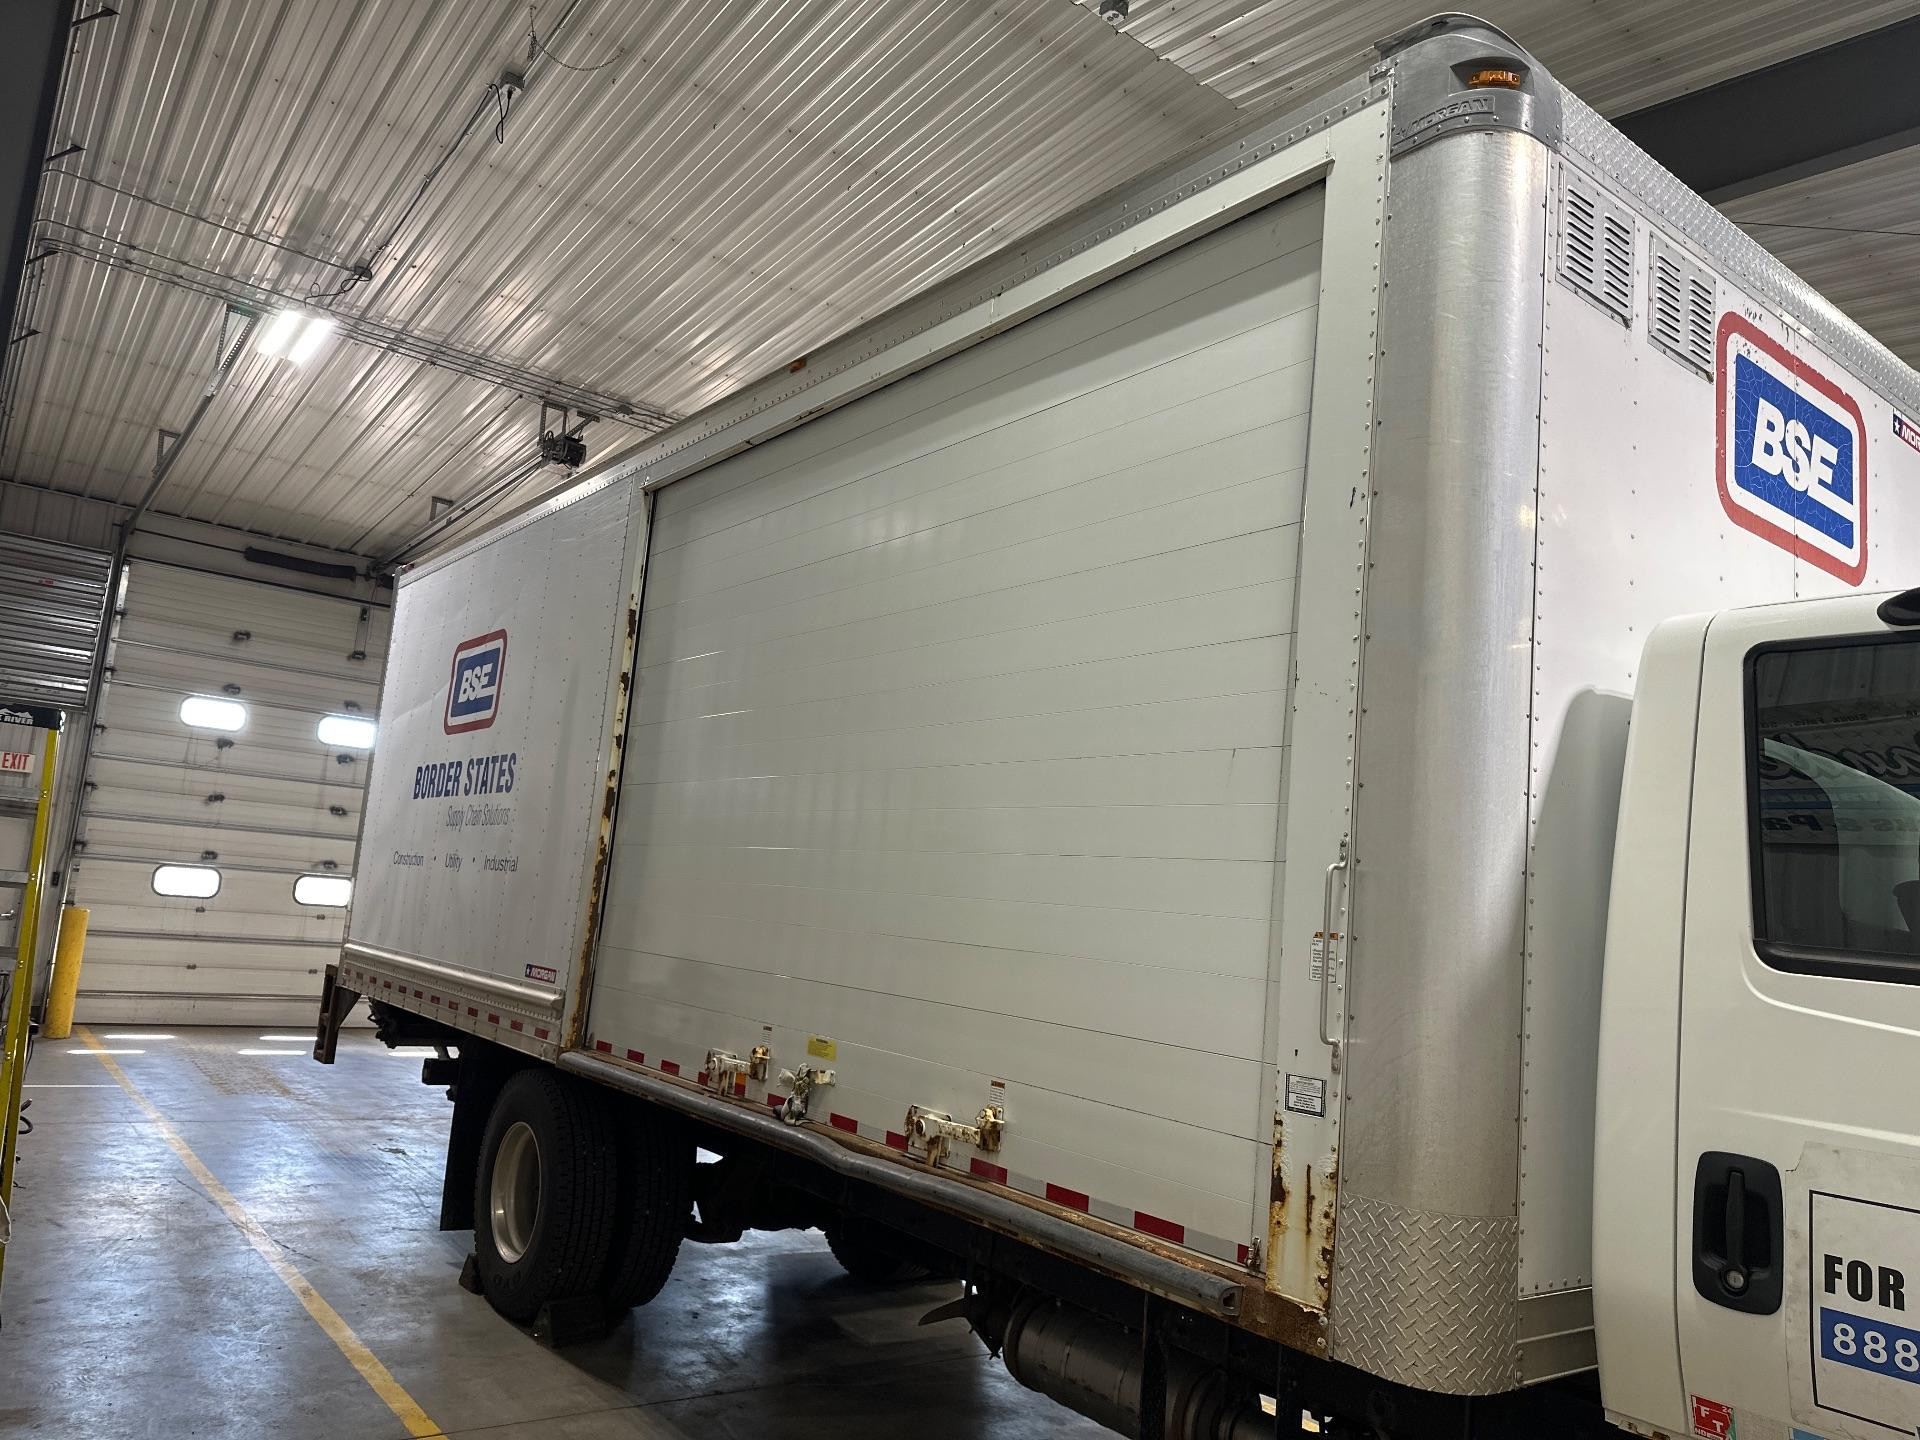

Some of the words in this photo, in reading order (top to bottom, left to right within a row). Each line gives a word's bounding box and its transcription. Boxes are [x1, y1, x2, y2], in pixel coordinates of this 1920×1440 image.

[1752, 397, 1847, 508] BSE
[457, 662, 495, 703] BSE
[4, 715, 34, 725] RIVER
[2, 752, 30, 771] EXIT
[413, 760, 463, 800] BORDER
[463, 752, 517, 797] STATES
[446, 805, 465, 832] Supply
[465, 804, 484, 827] Chain
[481, 803, 511, 827] Solutions
[393, 850, 424, 867] Construction
[445, 852, 463, 873] Utility
[483, 854, 519, 873] Industrial
[531, 966, 556, 982] MORGAN
[1824, 1253, 1905, 1312] FOR
[1833, 1322, 1920, 1373] 888
